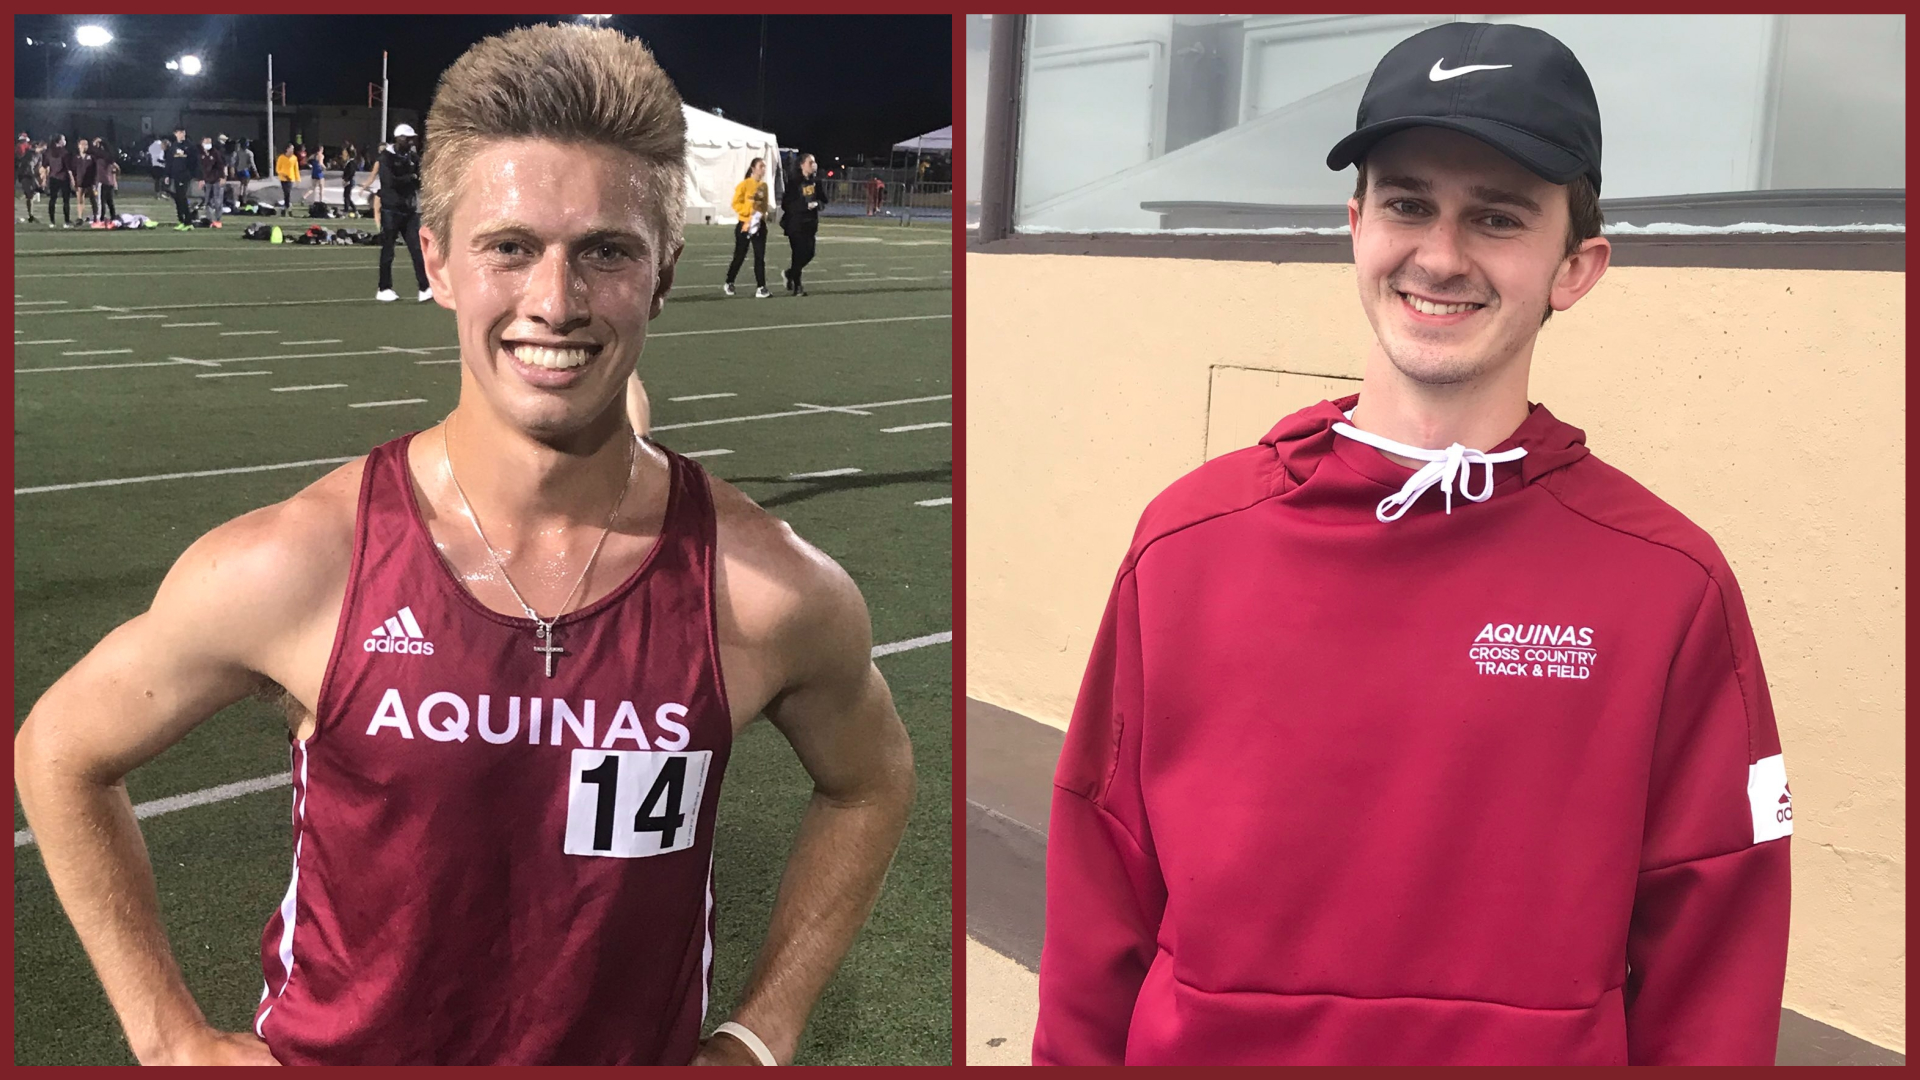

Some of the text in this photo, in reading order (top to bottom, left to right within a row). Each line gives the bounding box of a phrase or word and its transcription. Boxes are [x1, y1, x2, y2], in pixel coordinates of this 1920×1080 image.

[363, 634, 435, 656] adidas
[1474, 623, 1595, 646] AQUINAS
[1469, 647, 1598, 665] CROSS COUNTRY
[1475, 661, 1590, 680] TRACK & FIELD
[365, 688, 691, 752] AQUINAS
[580, 755, 688, 852] 14
